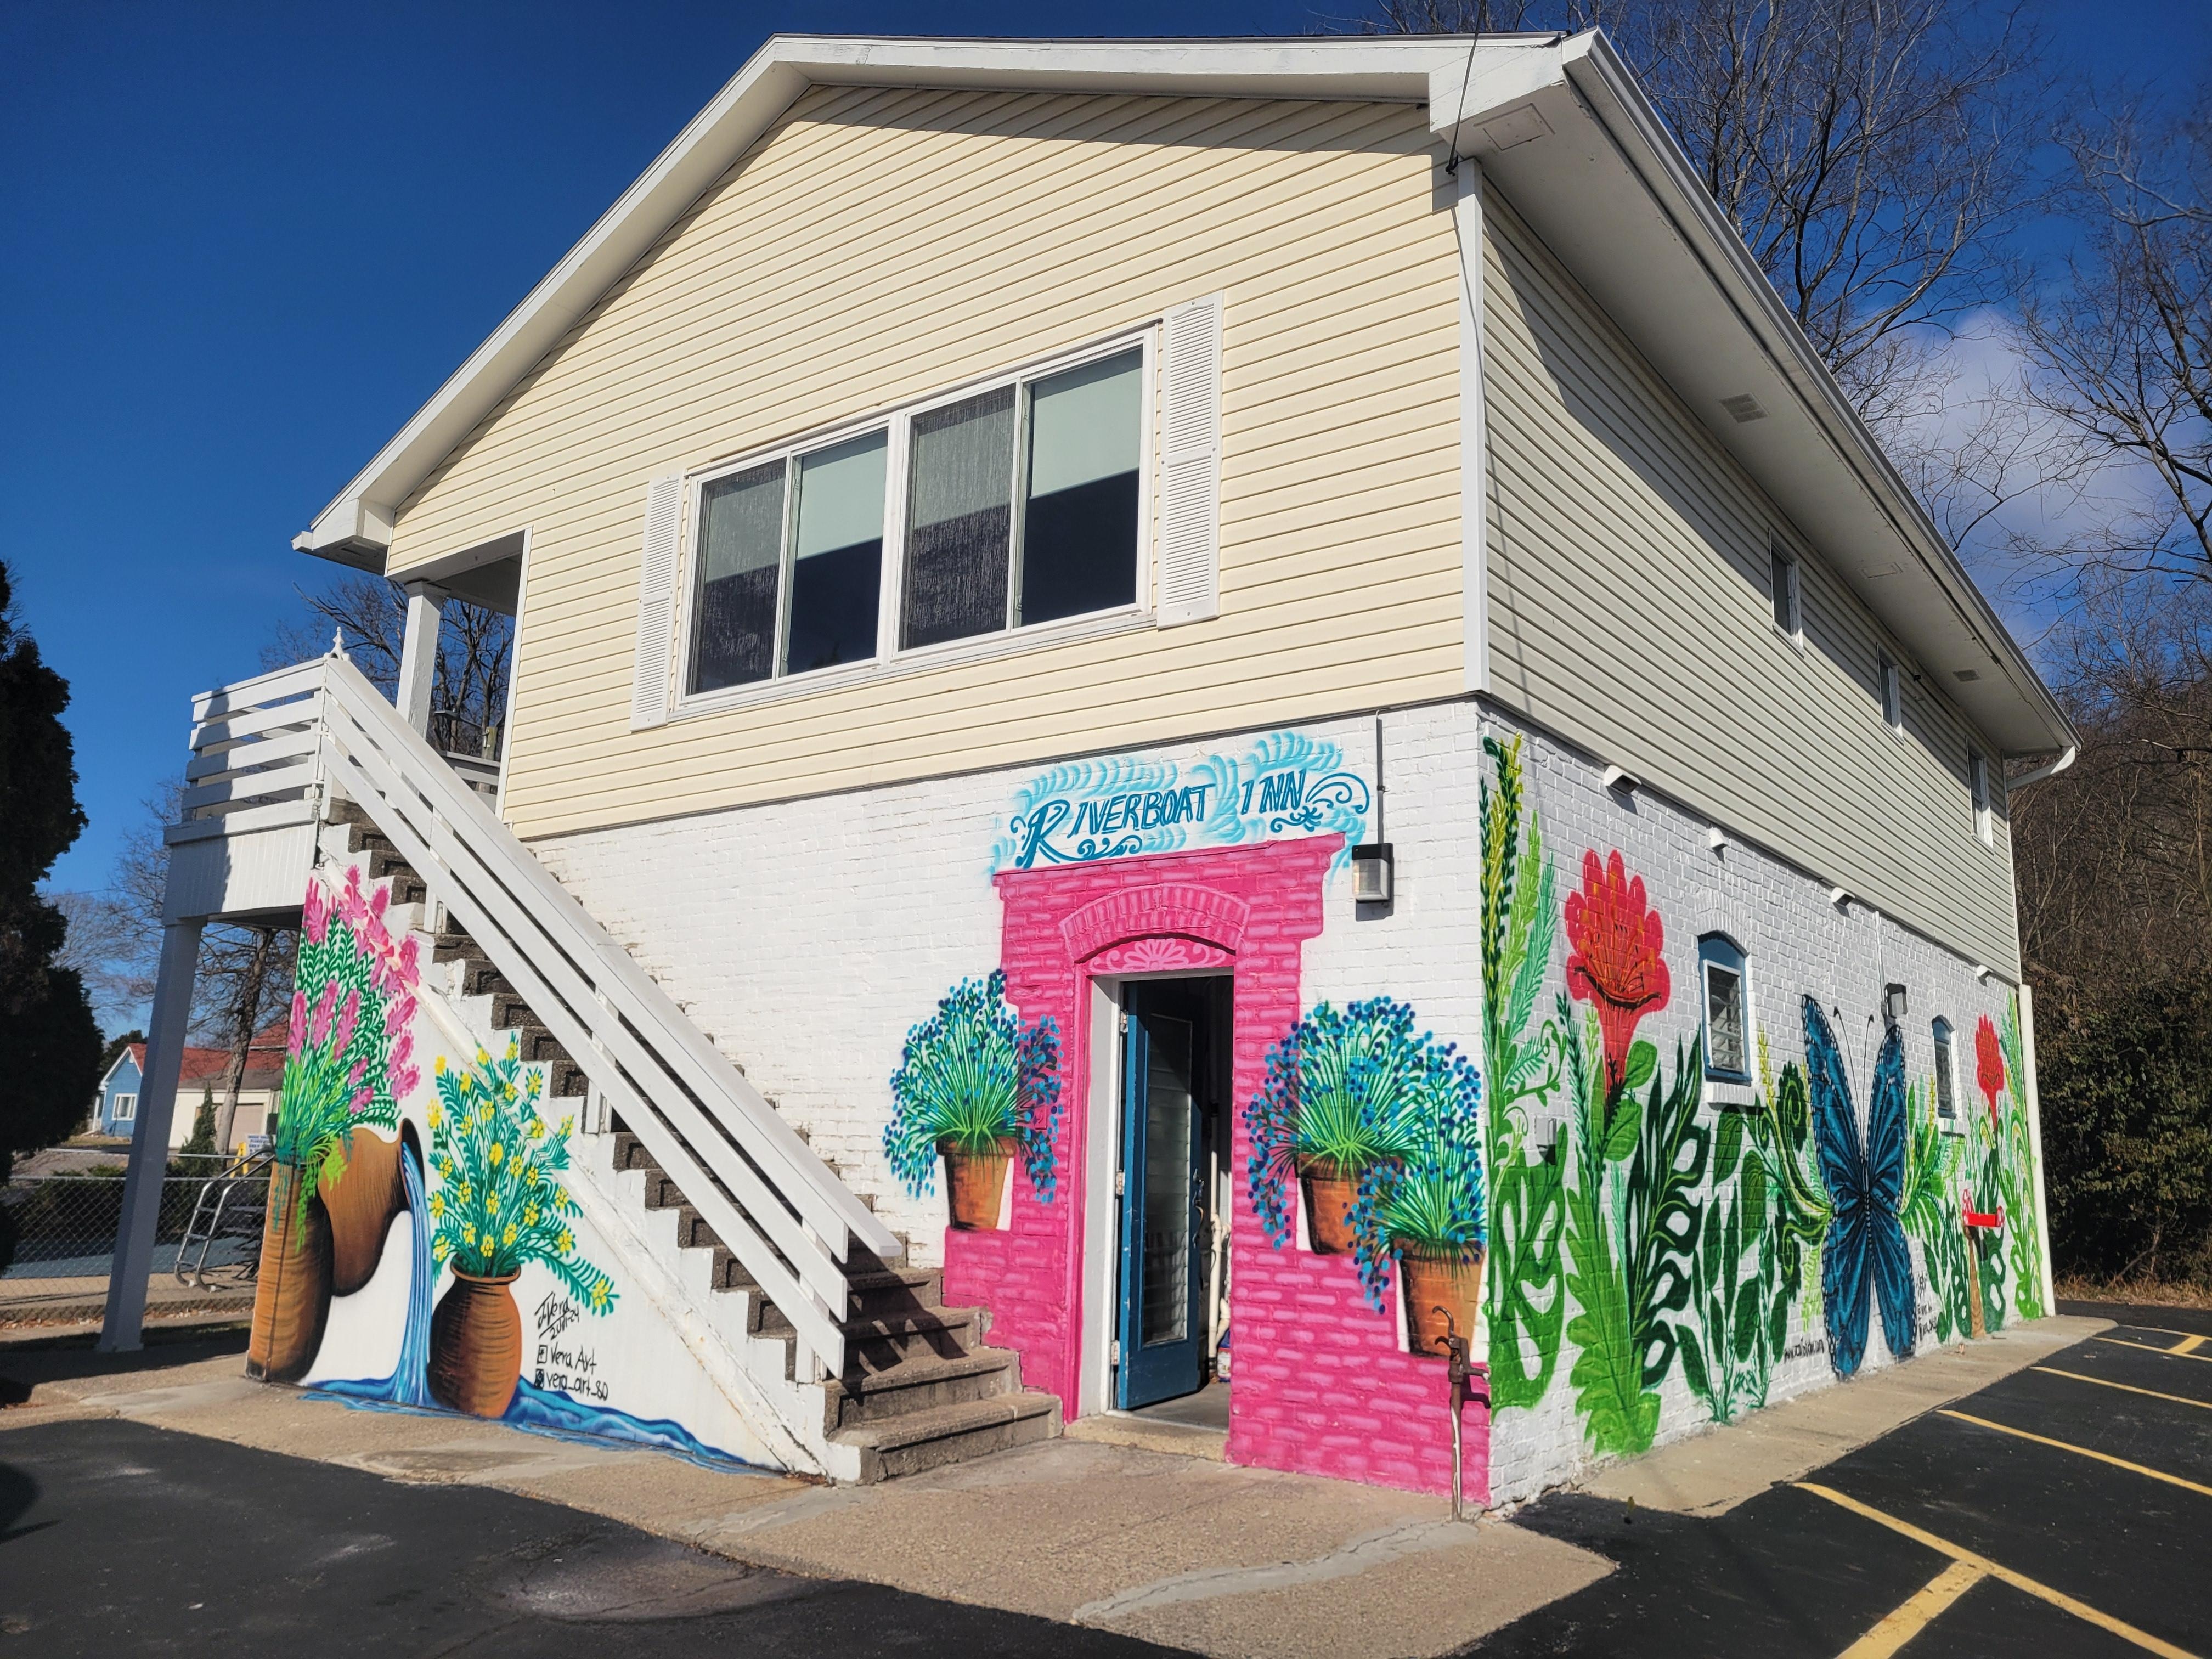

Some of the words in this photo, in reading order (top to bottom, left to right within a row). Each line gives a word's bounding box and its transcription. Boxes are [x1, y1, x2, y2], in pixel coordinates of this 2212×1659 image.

[1015, 783, 1216, 870] RIVERBOAT
[1242, 768, 1307, 815] INN
[551, 1341, 573, 1369] Vera
[574, 1344, 597, 1375] Art
